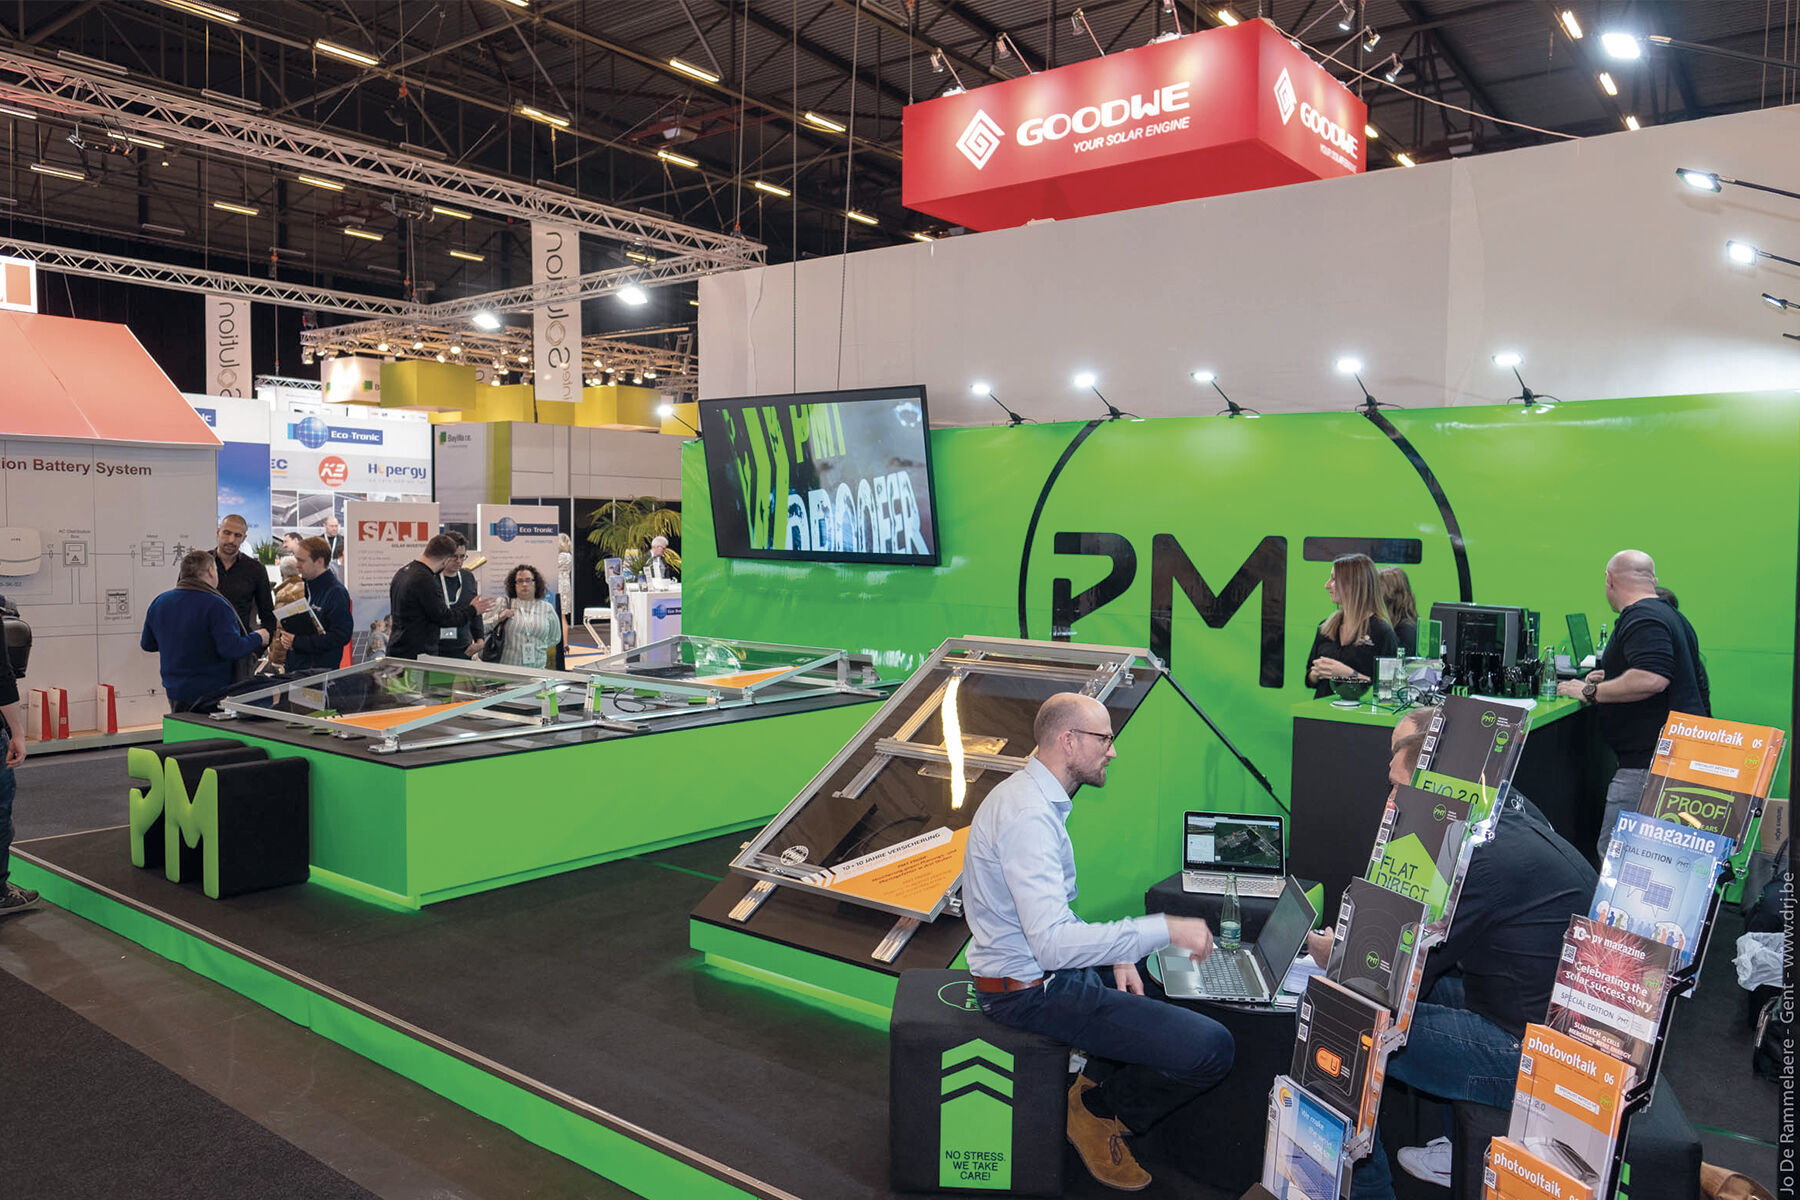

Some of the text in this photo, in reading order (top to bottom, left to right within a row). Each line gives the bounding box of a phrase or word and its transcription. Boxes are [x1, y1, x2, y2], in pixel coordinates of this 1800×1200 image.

[1016, 82, 1190, 146] GOODWE
[1074, 116, 1190, 153] YOUR SOLAR ENGINE
[1300, 102, 1358, 159] GOODWE
[34, 458, 90, 476] Battery
[96, 462, 152, 476] System
[321, 463, 346, 478] K2
[360, 520, 420, 542] SAJ
[1052, 531, 1422, 690] PMT
[1481, 715, 1496, 723] PMT
[1668, 722, 1744, 746] photovoltaik
[1752, 738, 1764, 750] 05
[1457, 790, 1480, 804] 20
[1667, 795, 1728, 820] PROOF
[1617, 817, 1638, 832] pv
[1640, 822, 1716, 854] magazine
[1700, 824, 1718, 832] EARS
[864, 852, 886, 864] JAHRE
[888, 832, 940, 855] VERSICHERUNG
[1641, 850, 1672, 864] EDITION
[1380, 856, 1418, 880] FLAT
[1376, 872, 1430, 902] DIRECT
[1591, 935, 1604, 944] pv
[1604, 938, 1646, 960] magazine
[1575, 962, 1648, 996] Celebrating the
[1565, 970, 1590, 988] solar
[1590, 981, 1626, 1001] success
[1627, 996, 1652, 1014] story
[1560, 992, 1614, 1019] SPECIAL EDITION
[1574, 1022, 1602, 1038] SUNTECH
[1528, 1036, 1598, 1076] photovoltaik
[1604, 1072, 1614, 1085] 06
[946, 1150, 960, 1160] NO
[953, 1162, 998, 1172] WE TAKE
[960, 1171, 991, 1180] CARE!
[1494, 1152, 1562, 1198] photovoltaik
